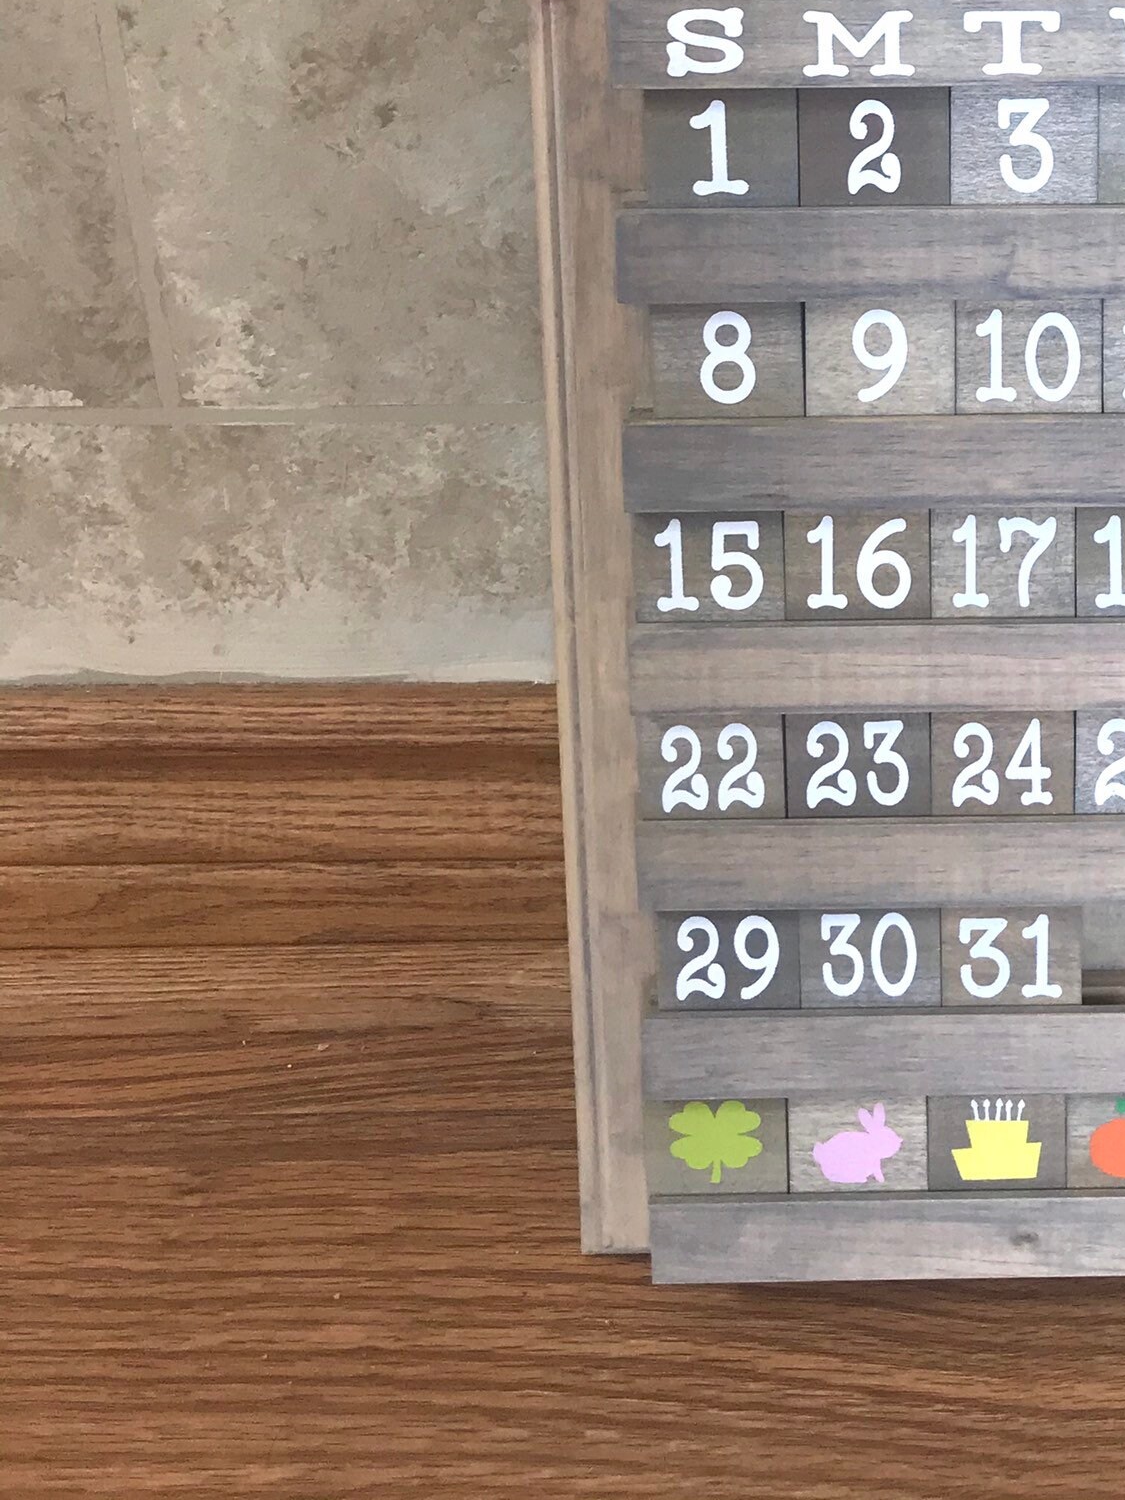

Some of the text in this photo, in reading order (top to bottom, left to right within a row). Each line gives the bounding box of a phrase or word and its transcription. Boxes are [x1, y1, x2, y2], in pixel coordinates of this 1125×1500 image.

[665, 6, 745, 78] S
[802, 9, 916, 77] M
[962, 10, 1061, 76] T
[688, 99, 751, 196] 1
[846, 99, 902, 195] 2
[997, 96, 1055, 194] 3
[699, 310, 757, 405] 8
[851, 308, 909, 403] 9
[975, 308, 1082, 403] 10
[653, 517, 765, 612] 15
[806, 515, 912, 610] 16
[951, 513, 1057, 609] 17
[660, 722, 766, 813] 22
[805, 719, 910, 809] 23
[951, 717, 1054, 809] 24
[675, 911, 1063, 1002] 29 30 31
